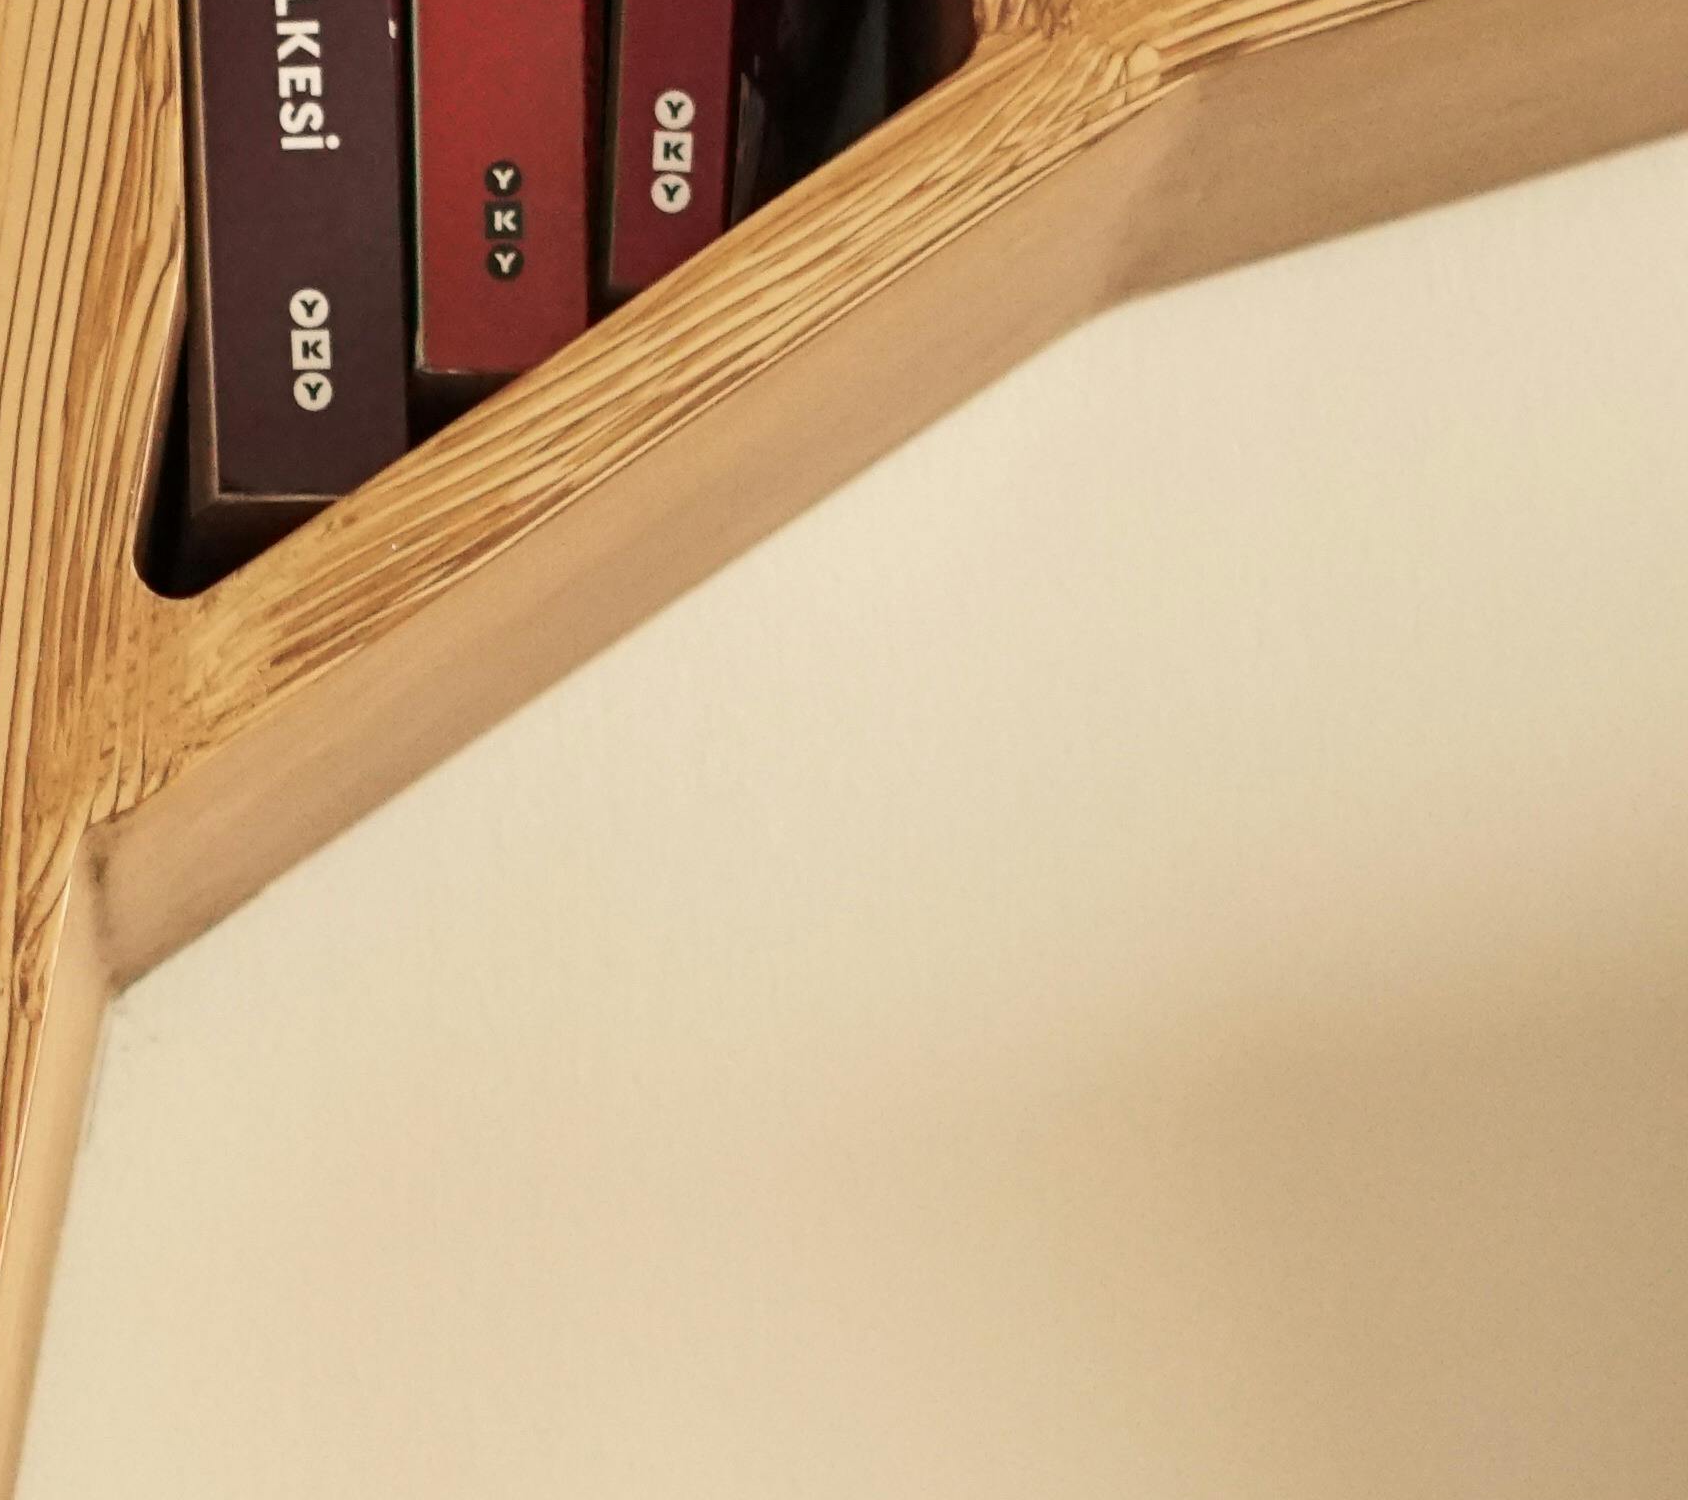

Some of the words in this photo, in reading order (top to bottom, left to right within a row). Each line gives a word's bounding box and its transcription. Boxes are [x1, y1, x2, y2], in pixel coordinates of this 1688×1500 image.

[650, 89, 695, 214] YKY
[484, 160, 525, 282] YKY
[288, 288, 334, 412] YKY
